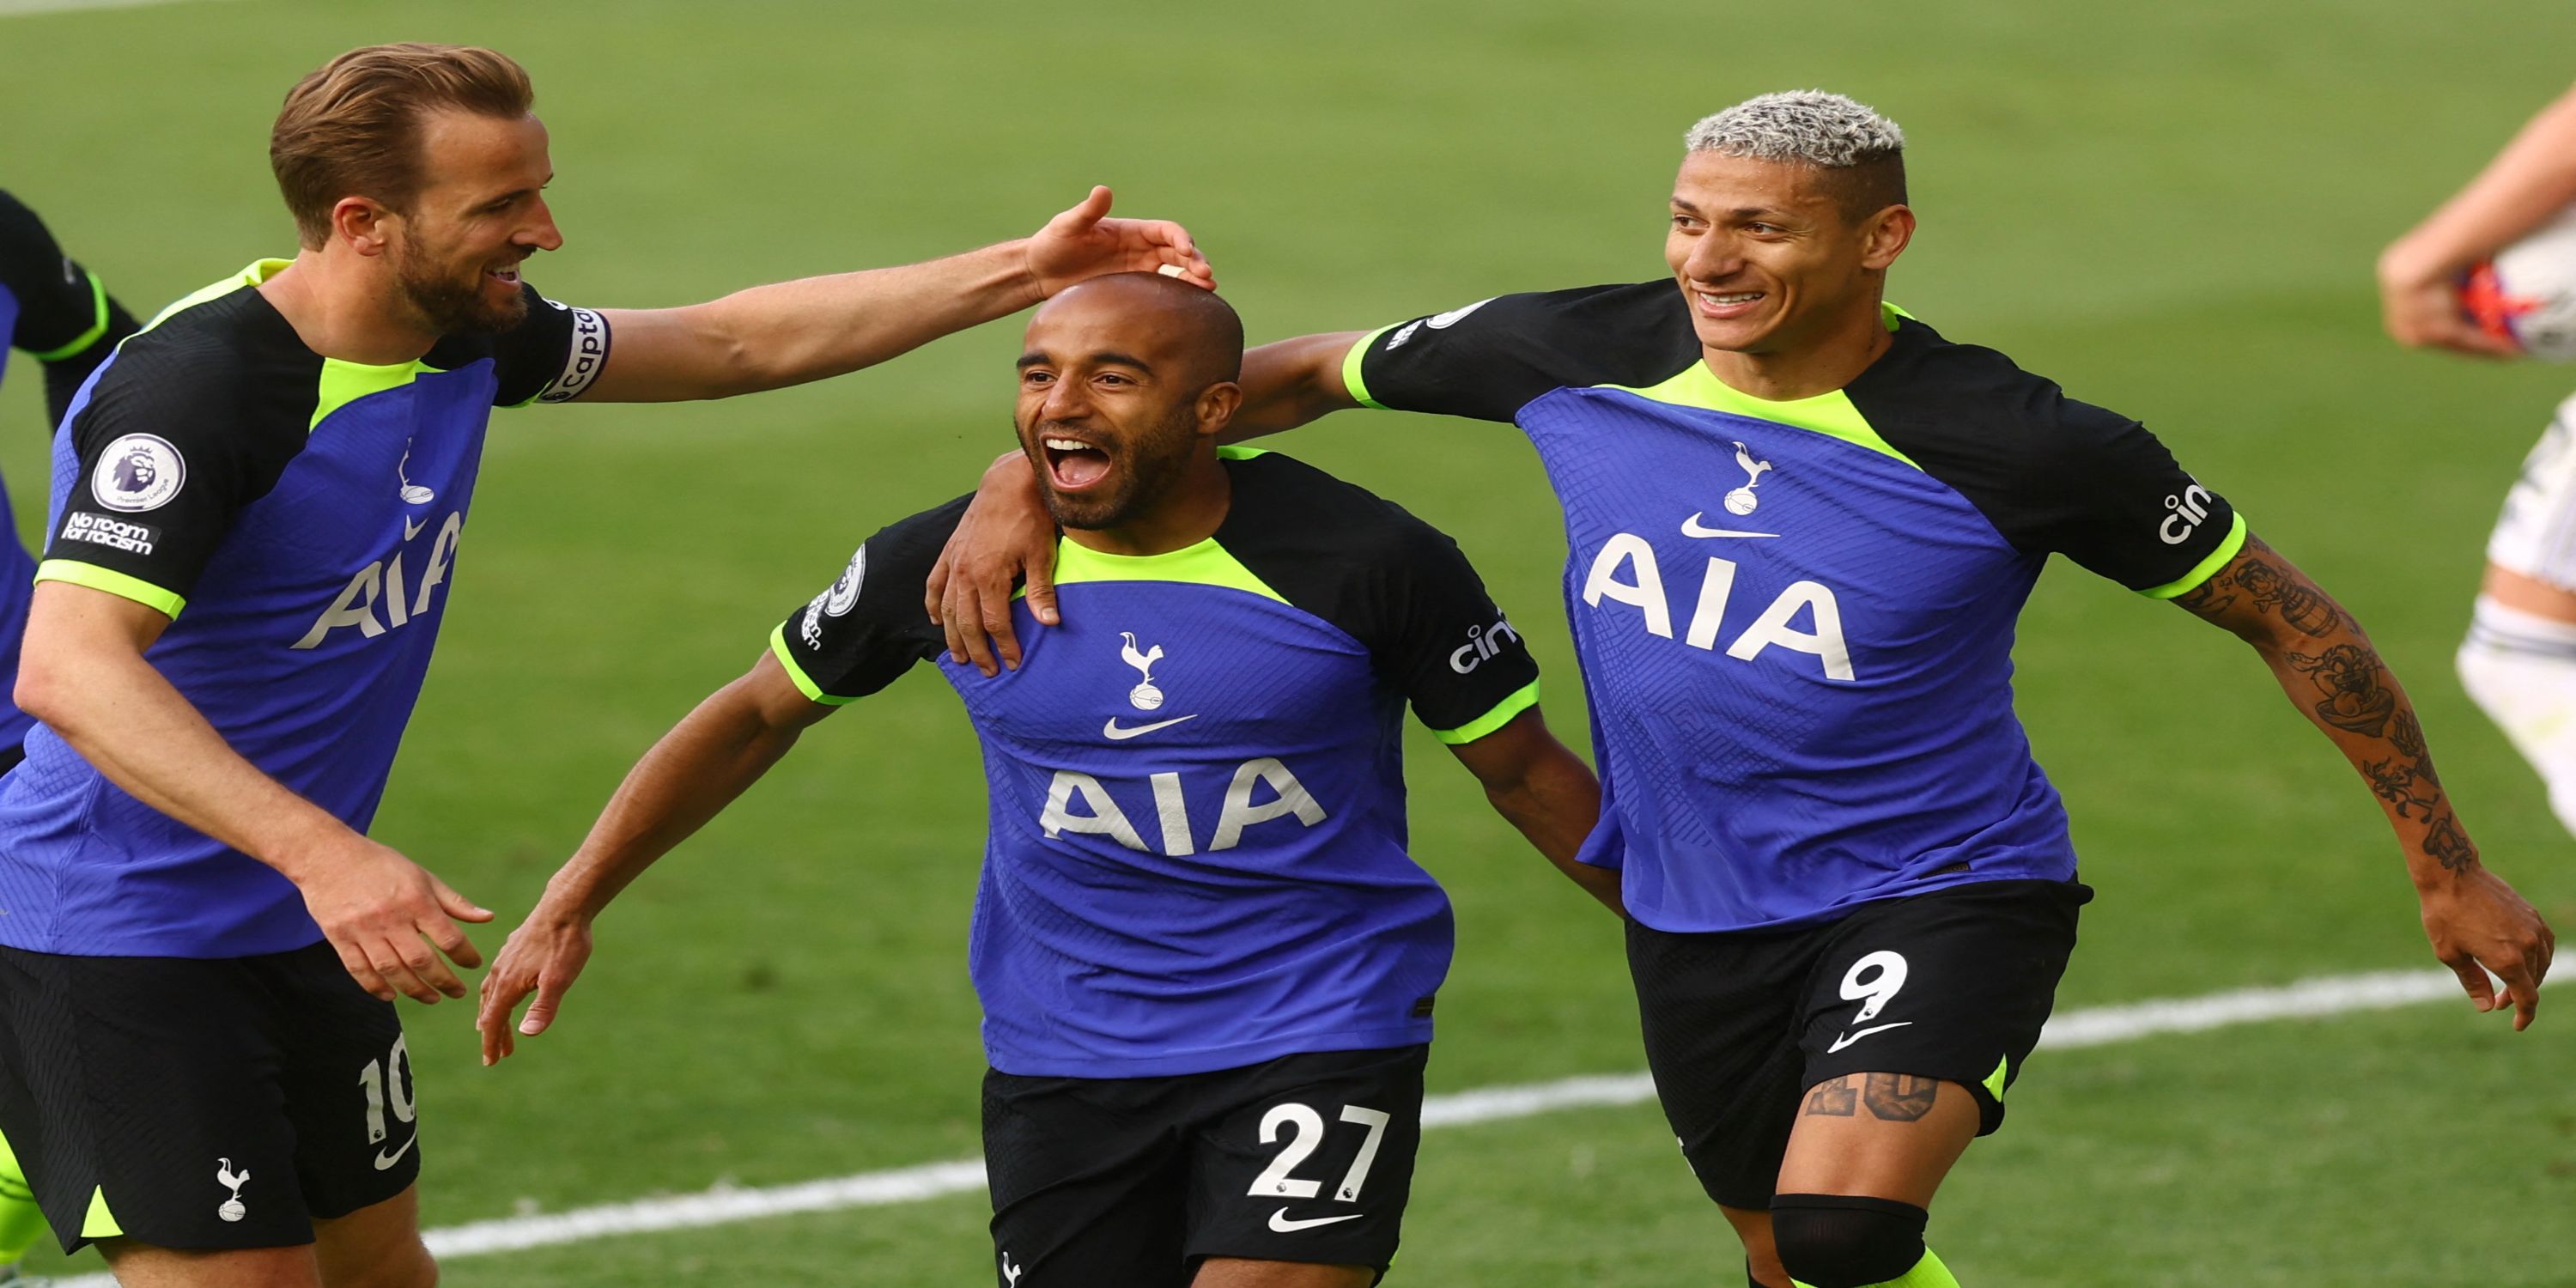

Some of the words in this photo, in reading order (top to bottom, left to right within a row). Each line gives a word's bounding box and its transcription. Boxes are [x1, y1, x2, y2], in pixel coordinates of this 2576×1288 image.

[68, 511, 94, 529] No
[93, 517, 149, 541] room
[117, 495, 149, 504] Premier
[148, 477, 169, 500] League
[2159, 474, 2212, 544] cin
[61, 524, 88, 539] for
[86, 529, 153, 556] racism
[1449, 606, 1517, 674] cin
[1583, 533, 1856, 681] AIA
[1039, 757, 1327, 856] AIA
[1839, 951, 1908, 1024] 9
[358, 1031, 416, 1145] 10
[1247, 1103, 1390, 1203] 27
